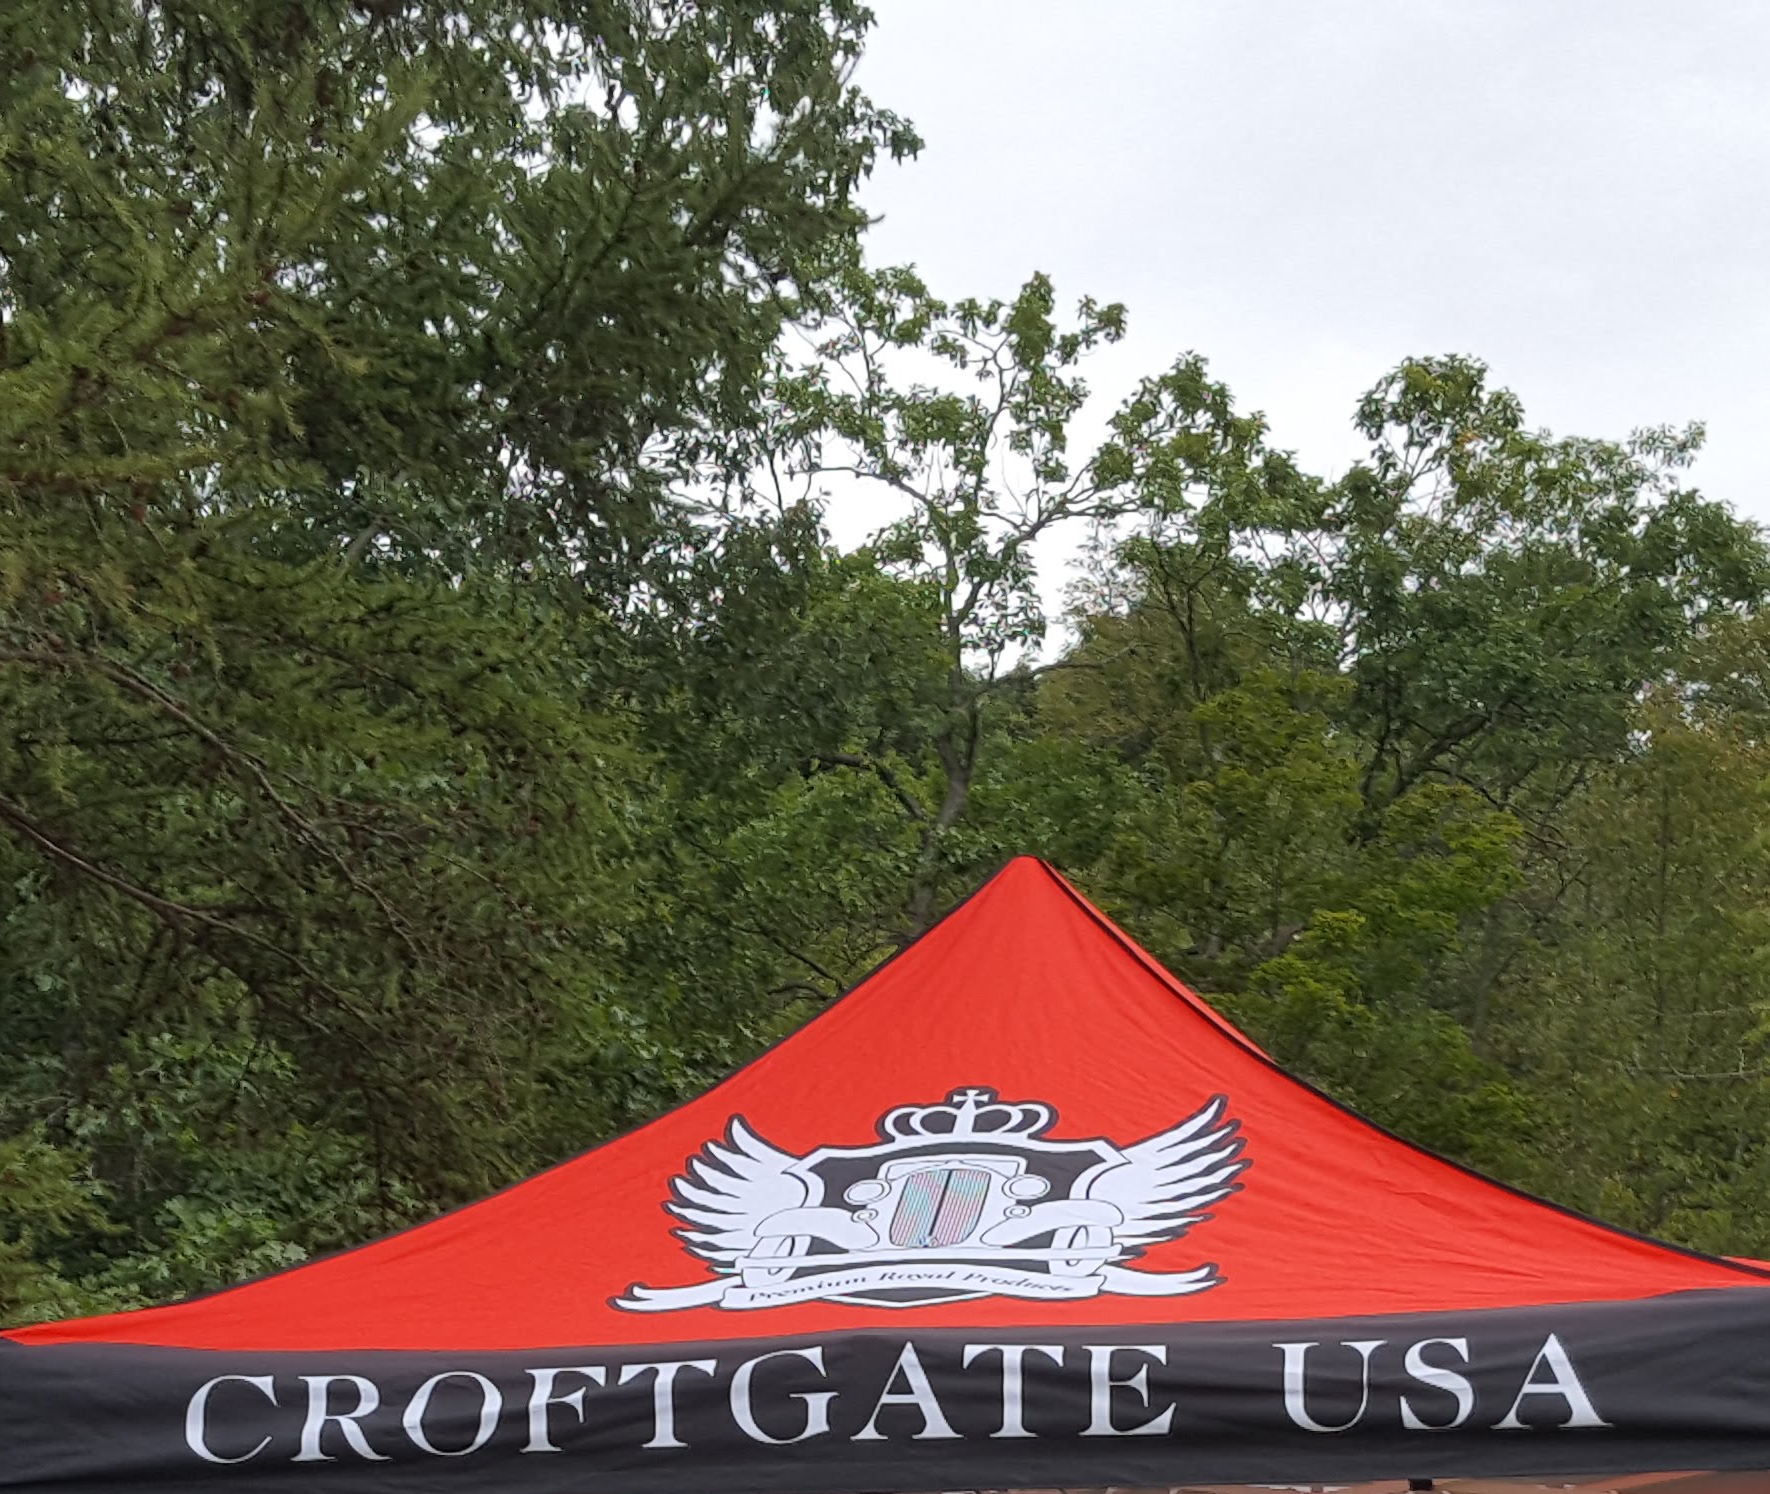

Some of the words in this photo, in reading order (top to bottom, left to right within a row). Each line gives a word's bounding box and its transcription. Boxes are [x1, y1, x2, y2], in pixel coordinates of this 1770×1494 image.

[750, 1277, 866, 1301] Premium
[879, 1270, 955, 1282] Royal
[963, 1273, 1075, 1292] Products
[184, 1341, 1177, 1464] CROFTGATE
[1271, 1331, 1615, 1433] USA
